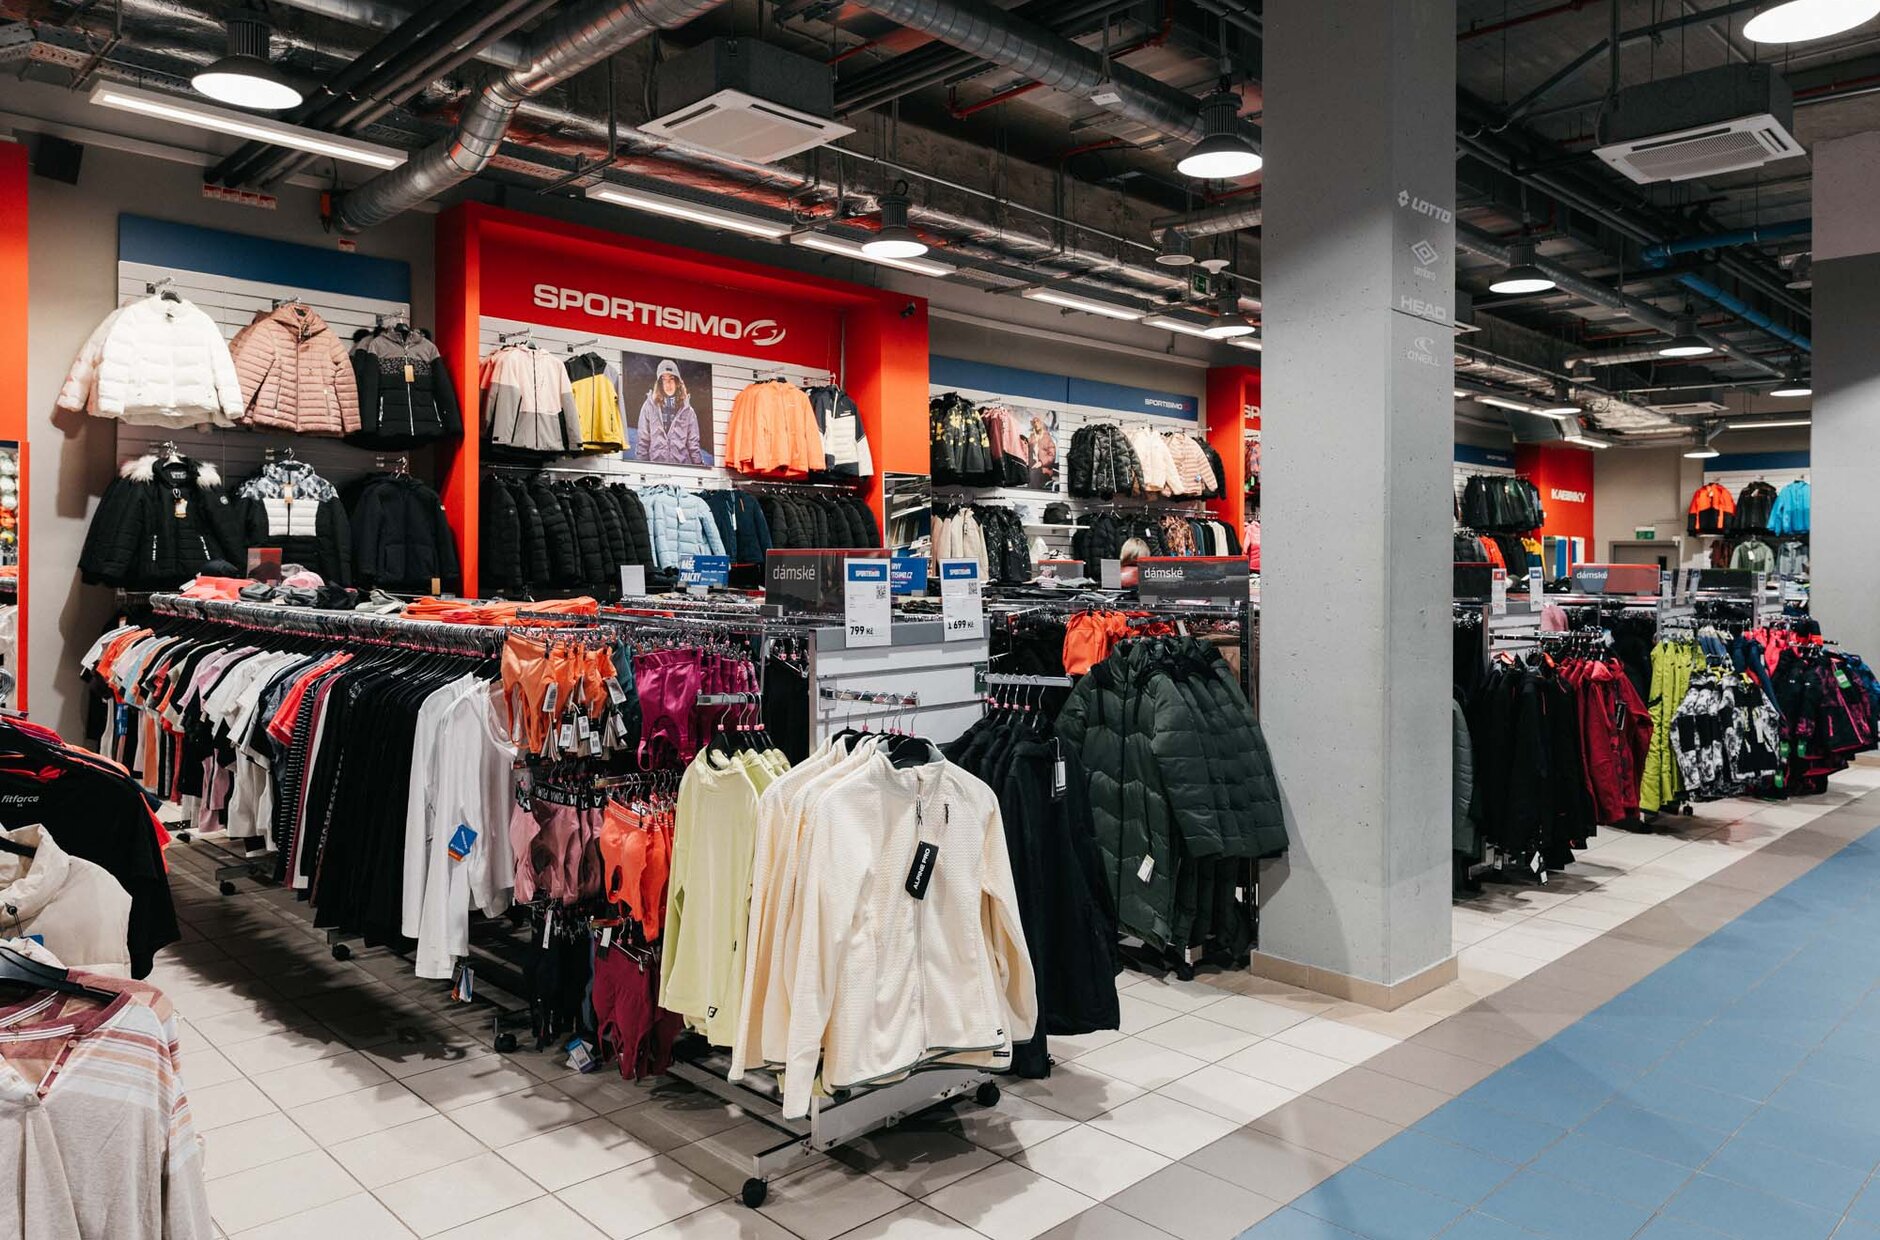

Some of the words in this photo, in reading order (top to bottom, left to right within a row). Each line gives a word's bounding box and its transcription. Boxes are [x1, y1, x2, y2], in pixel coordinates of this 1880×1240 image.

[1411, 197, 1452, 223] LOTTO
[533, 283, 743, 340] SPORTISIMO
[1400, 295, 1447, 320] HEAD
[1144, 398, 1183, 411] SPORTISIMO
[772, 564, 816, 580] dámské
[1144, 566, 1184, 579] dámské
[1576, 570, 1608, 579] dámské
[850, 625, 865, 636] 799
[953, 620, 966, 630] 699
[913, 863, 926, 890] ALPINE
[921, 848, 931, 864] PRO
